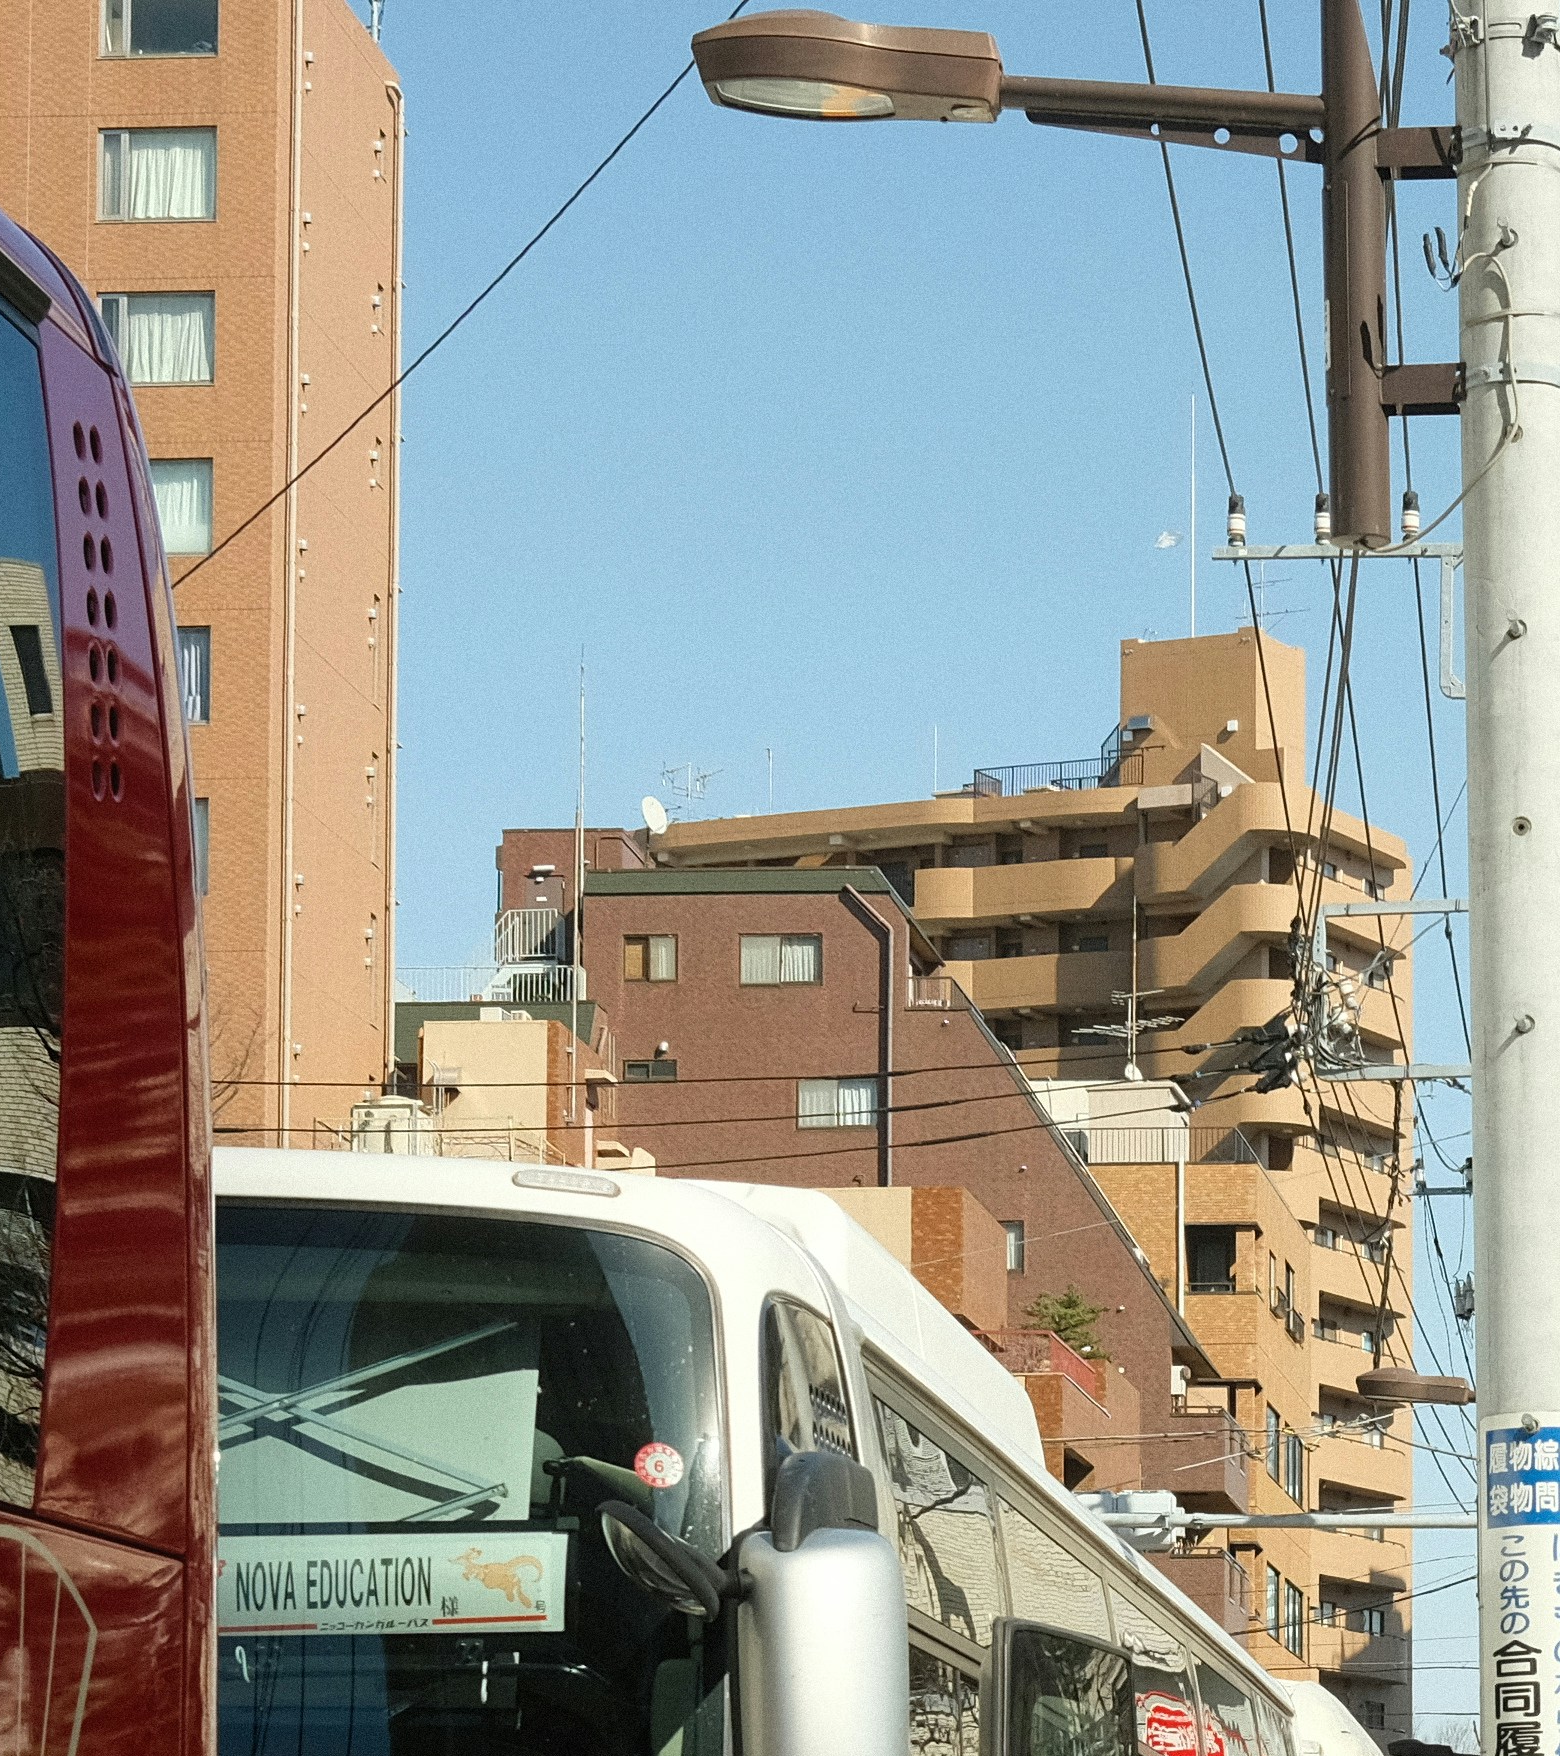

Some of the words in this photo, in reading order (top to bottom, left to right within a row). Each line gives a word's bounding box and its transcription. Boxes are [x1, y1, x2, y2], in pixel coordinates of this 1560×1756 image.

[654, 1460, 665, 1473] 6
[236, 1561, 297, 1612] NOVA
[306, 1557, 432, 1609] EDUCATION
[441, 1596, 460, 1618] 様
